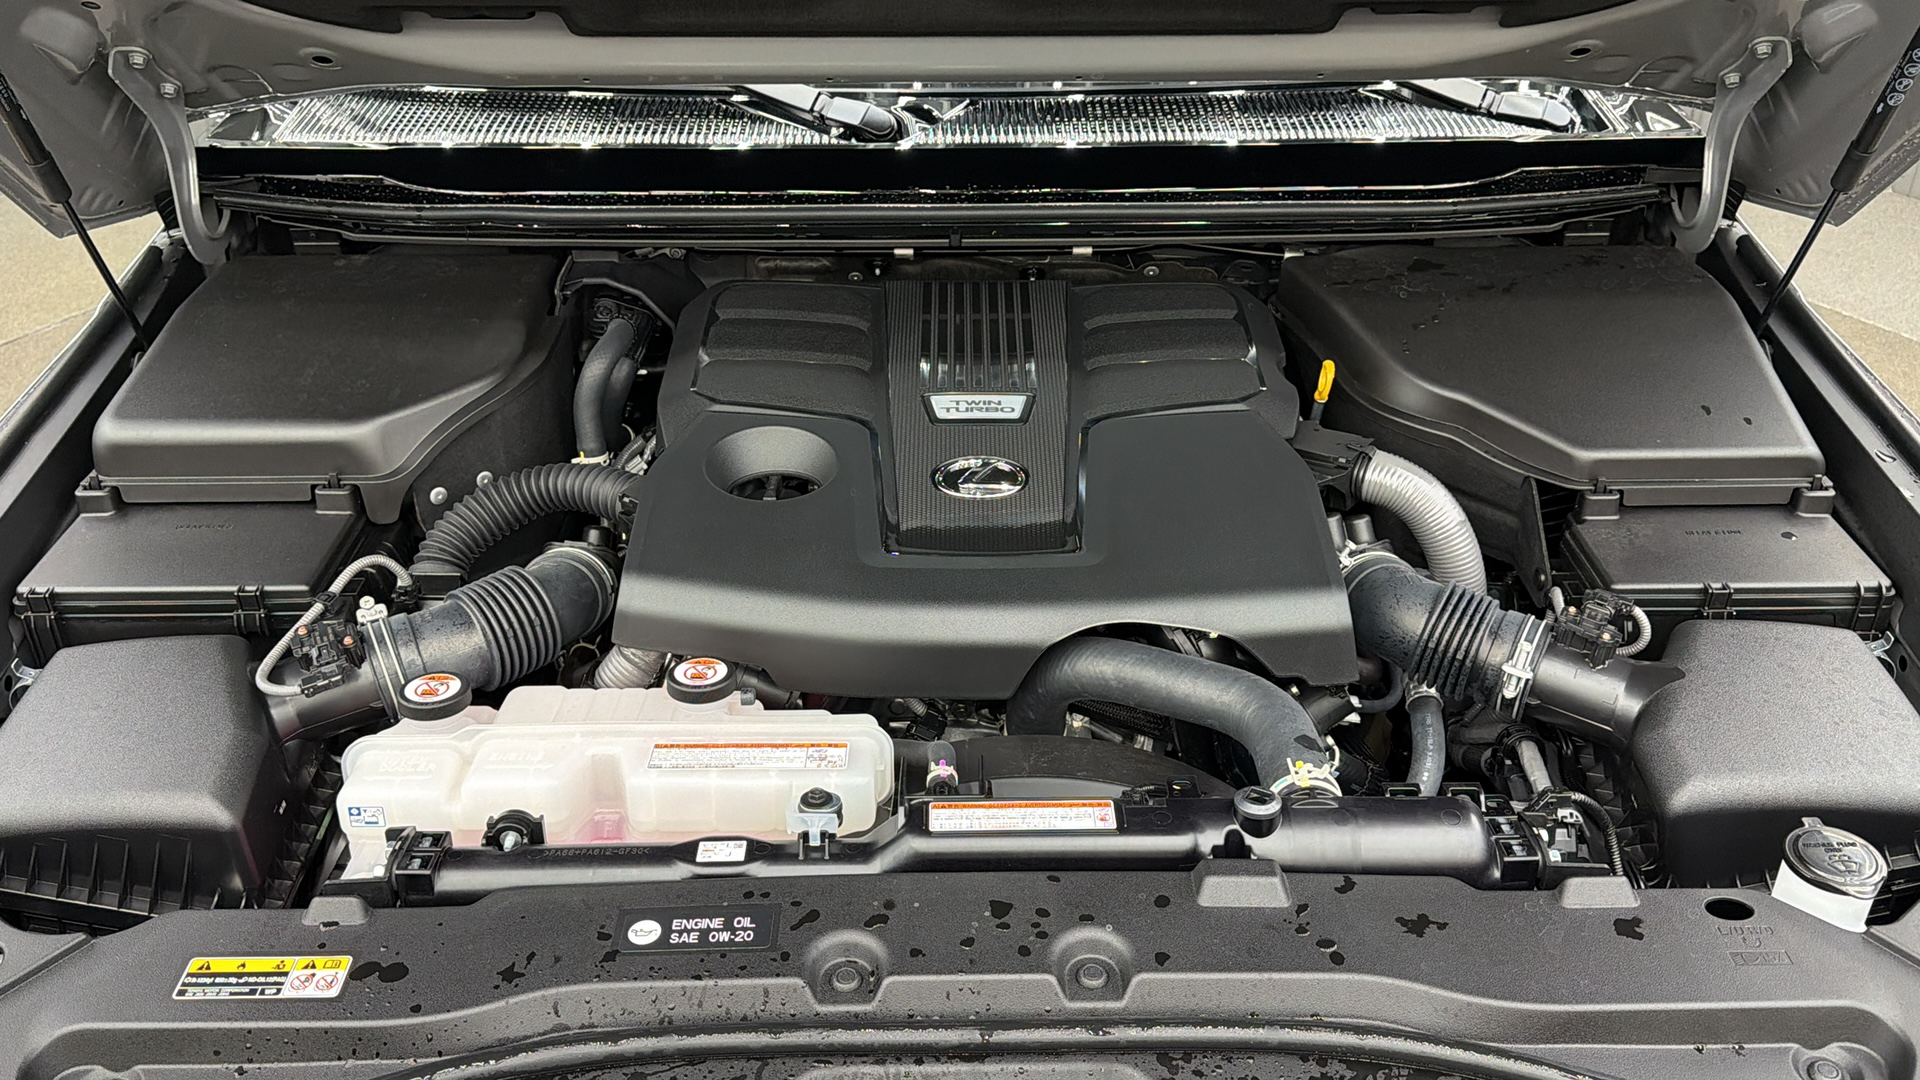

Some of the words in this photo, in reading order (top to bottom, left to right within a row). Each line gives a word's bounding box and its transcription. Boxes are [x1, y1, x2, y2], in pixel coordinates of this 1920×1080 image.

[671, 918, 725, 930] ENGINE
[733, 916, 756, 928] OIL
[669, 932, 700, 944] SAE
[708, 930, 754, 943] 0W-20
